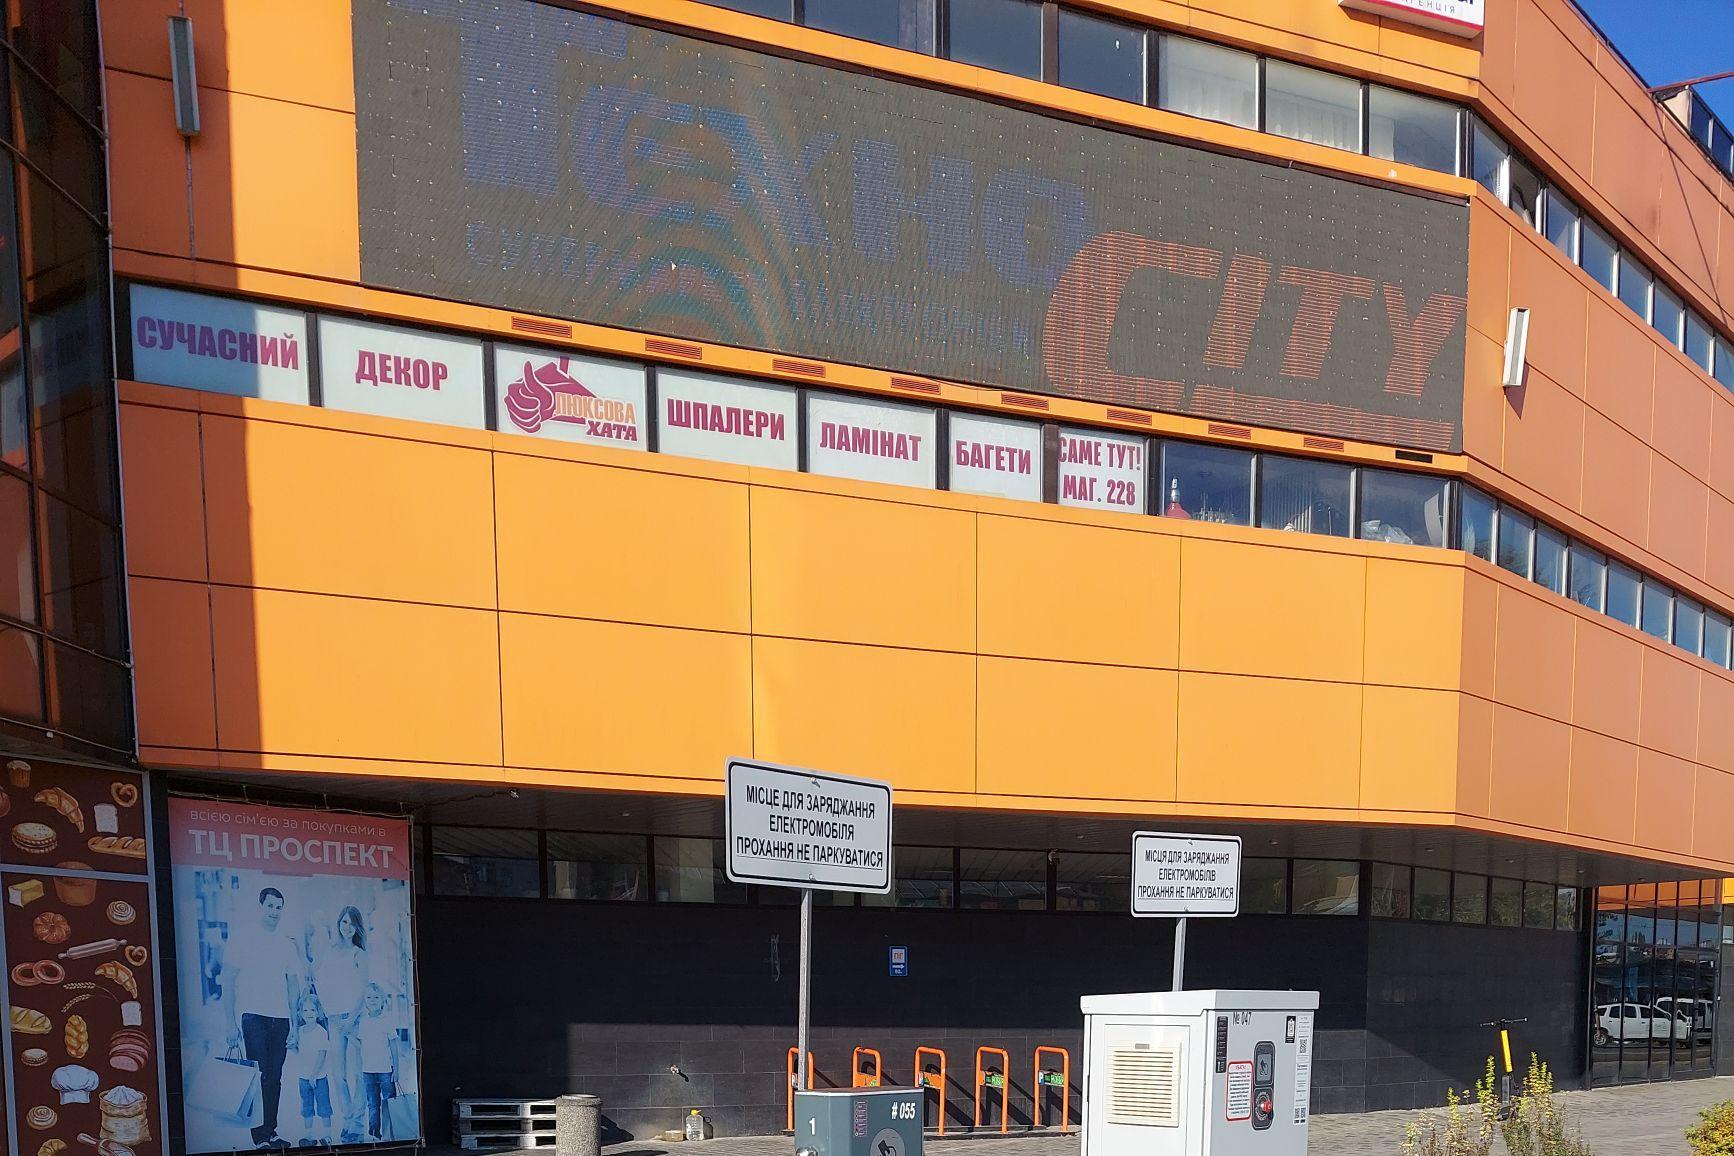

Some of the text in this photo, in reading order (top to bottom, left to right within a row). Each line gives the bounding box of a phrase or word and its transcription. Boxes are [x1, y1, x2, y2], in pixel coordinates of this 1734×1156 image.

[1402, 0, 1455, 13] ЕНЦІЯ
[1042, 230, 1467, 413] CITY
[137, 316, 299, 370] СУЧАСНИЙ
[355, 350, 448, 391] ДЕКОР
[555, 392, 637, 425] ЛЮКСОВА
[667, 398, 785, 441] ШПАЛЕРИ
[586, 420, 638, 442] ХАТА
[819, 421, 922, 462] ЛАМІНАТ
[955, 439, 1031, 475] БАГЕТИ
[1058, 436, 1141, 471] САМЕ ТУТ!
[1063, 474, 1136, 506] МАГ. 228
[746, 785, 875, 819] МІСЦЕ ДЛЯ ЗАРЯДЖАННЯ
[190, 809, 231, 823] всією
[283, 818, 298, 829] за
[302, 819, 375, 836] покупками
[378, 827, 386, 837] в
[769, 814, 854, 841] ЕЛЕКТРОМОБІЛЯ
[188, 829, 394, 869] ТЦ ПРОСПЕКТ
[736, 836, 883, 867] ПРОХАННЯ НЕ ПАРКУВАТИСЯ
[1168, 851, 1182, 865] ДЛЯ
[1183, 851, 1230, 866] ЗАРЯДЖАННЯ
[1137, 885, 1234, 899] ПРОХАННЯ НЕ ПАРКУВАТИСЯ
[808, 1117, 816, 1135] 1
[899, 1102, 915, 1120] 055
